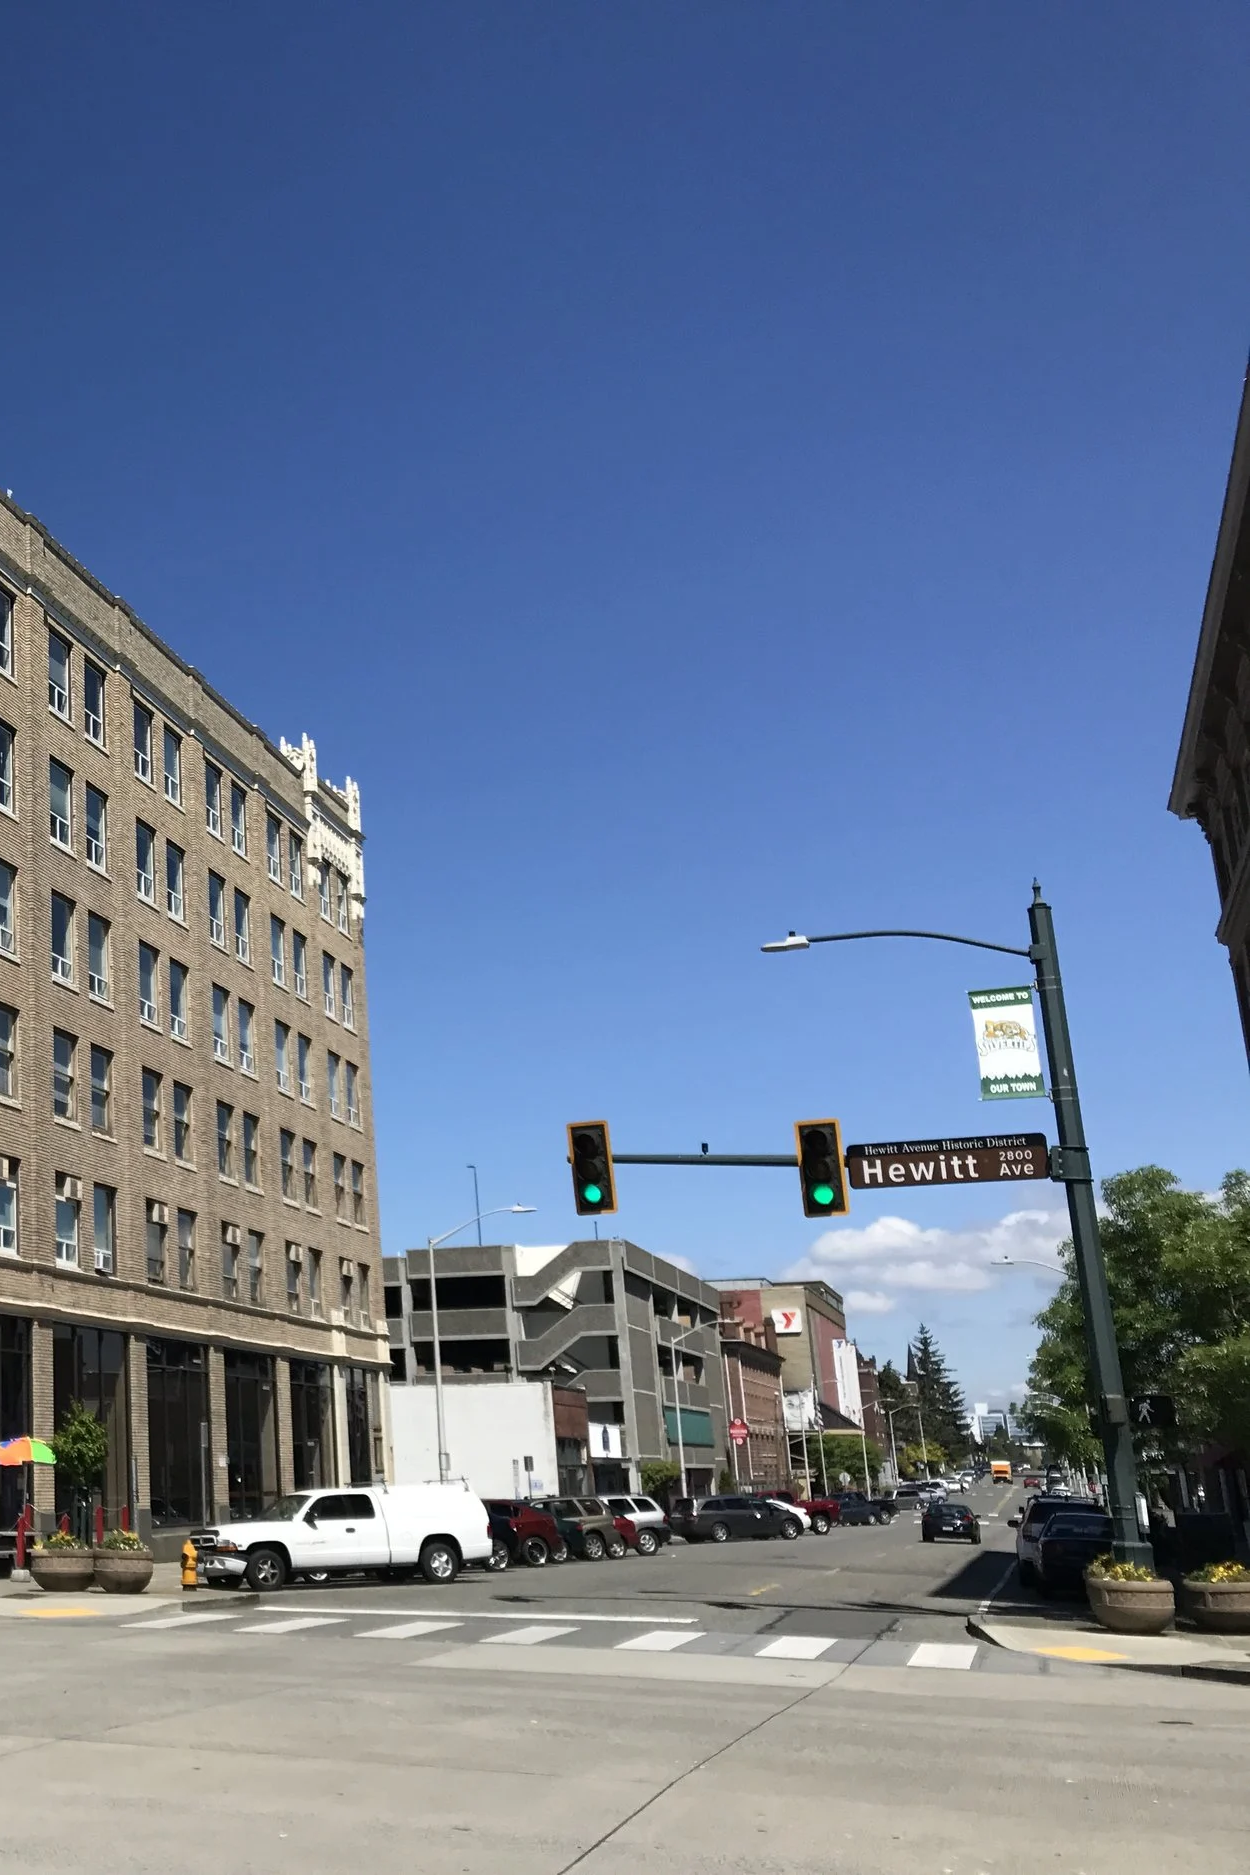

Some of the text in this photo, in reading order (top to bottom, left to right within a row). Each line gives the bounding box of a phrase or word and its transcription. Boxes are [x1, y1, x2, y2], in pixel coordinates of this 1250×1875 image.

[972, 991, 1029, 1004] WELCOME TO
[990, 1082, 1037, 1093] OUR TOWN
[864, 1136, 1027, 1156] Hewitt Avenue Historic District
[999, 1149, 1033, 1162] 2800
[862, 1154, 1034, 1185] Hewitt Ave
